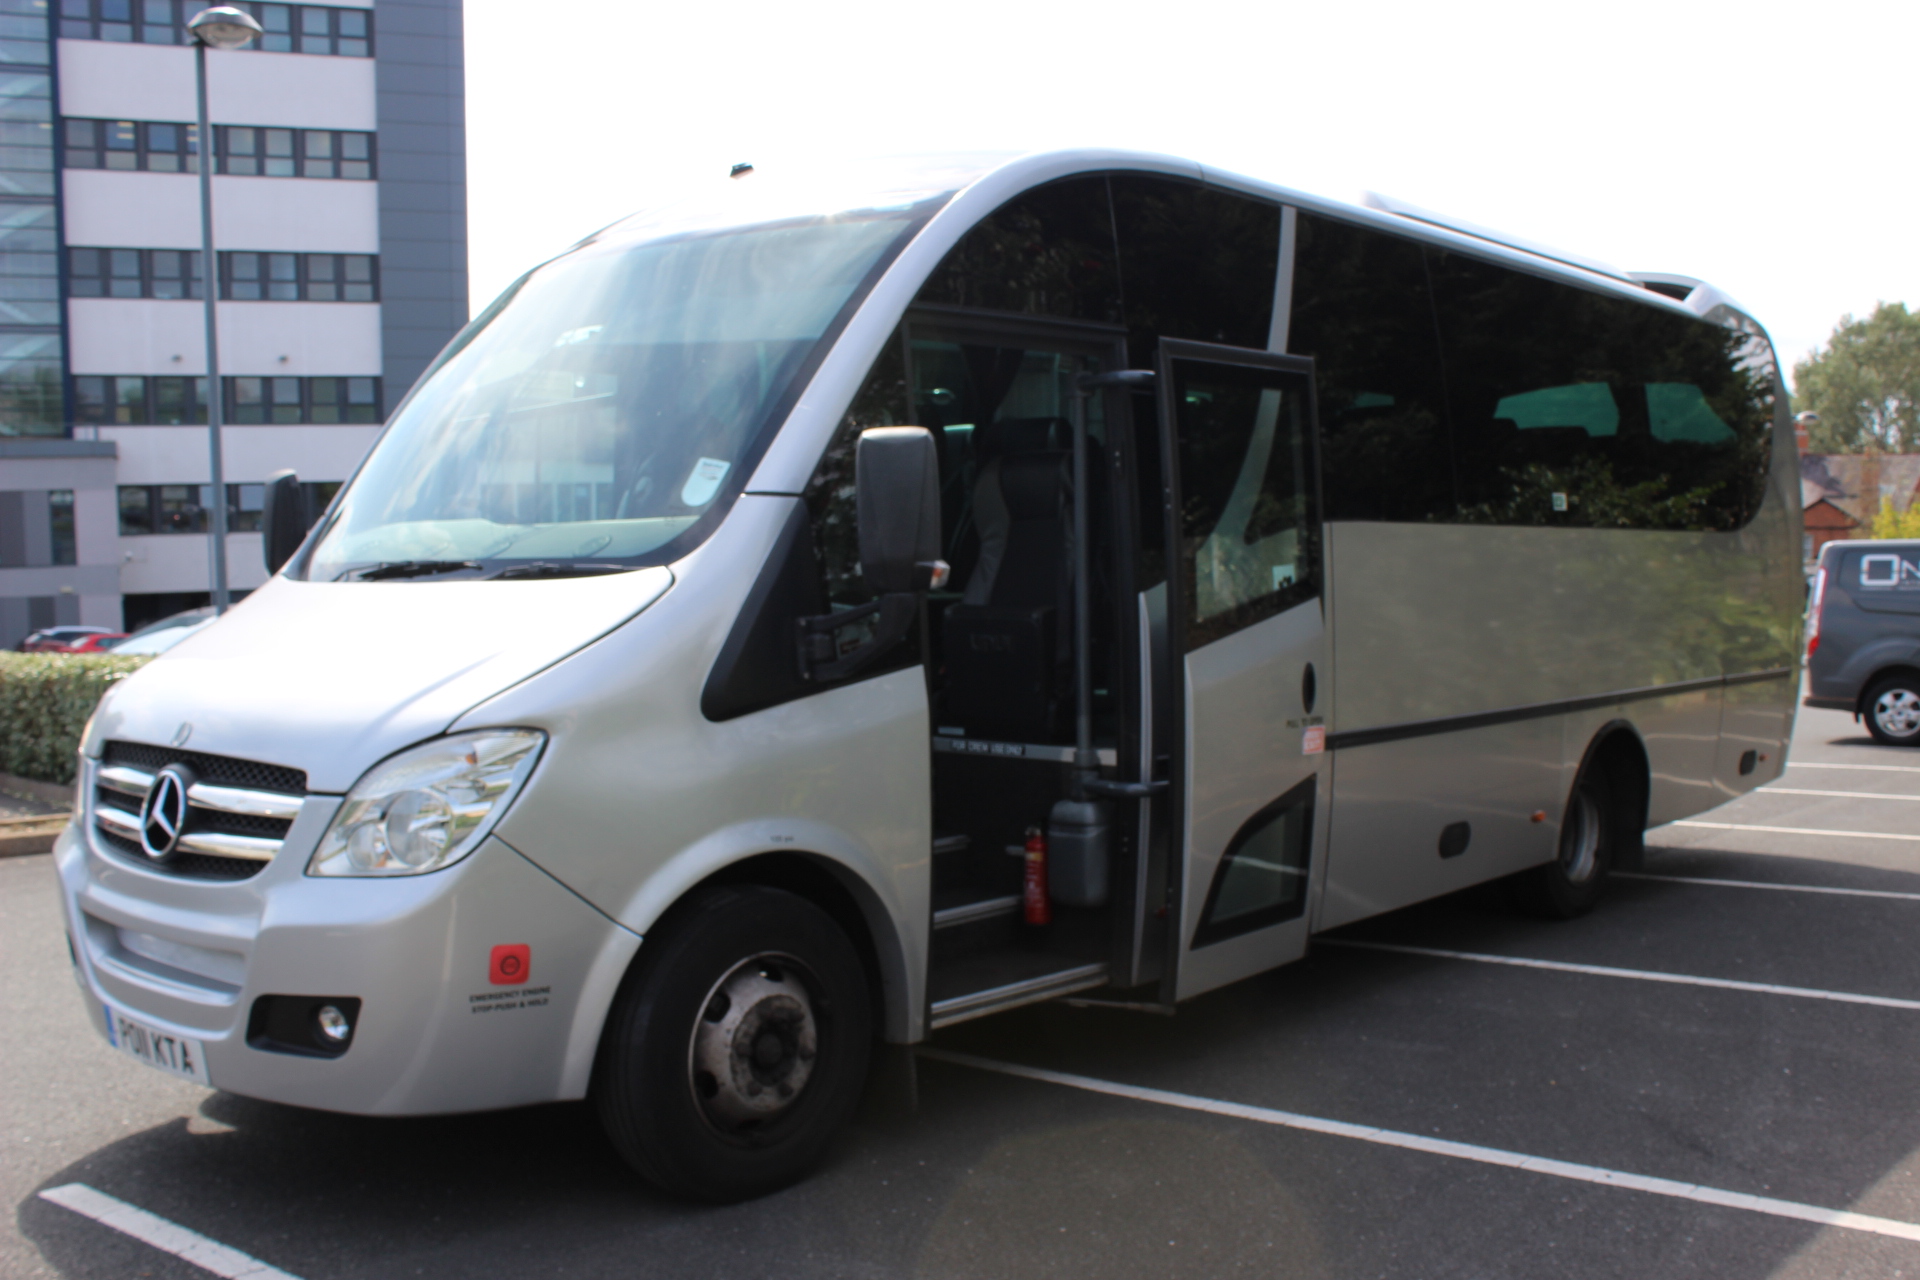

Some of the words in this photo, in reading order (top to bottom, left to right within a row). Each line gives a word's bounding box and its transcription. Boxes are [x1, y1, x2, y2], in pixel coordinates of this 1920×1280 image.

[469, 990, 519, 1003] EMERGENCY
[521, 986, 551, 997] ENGINE
[527, 997, 549, 1007] HOLD
[150, 1031, 195, 1075] KTA
